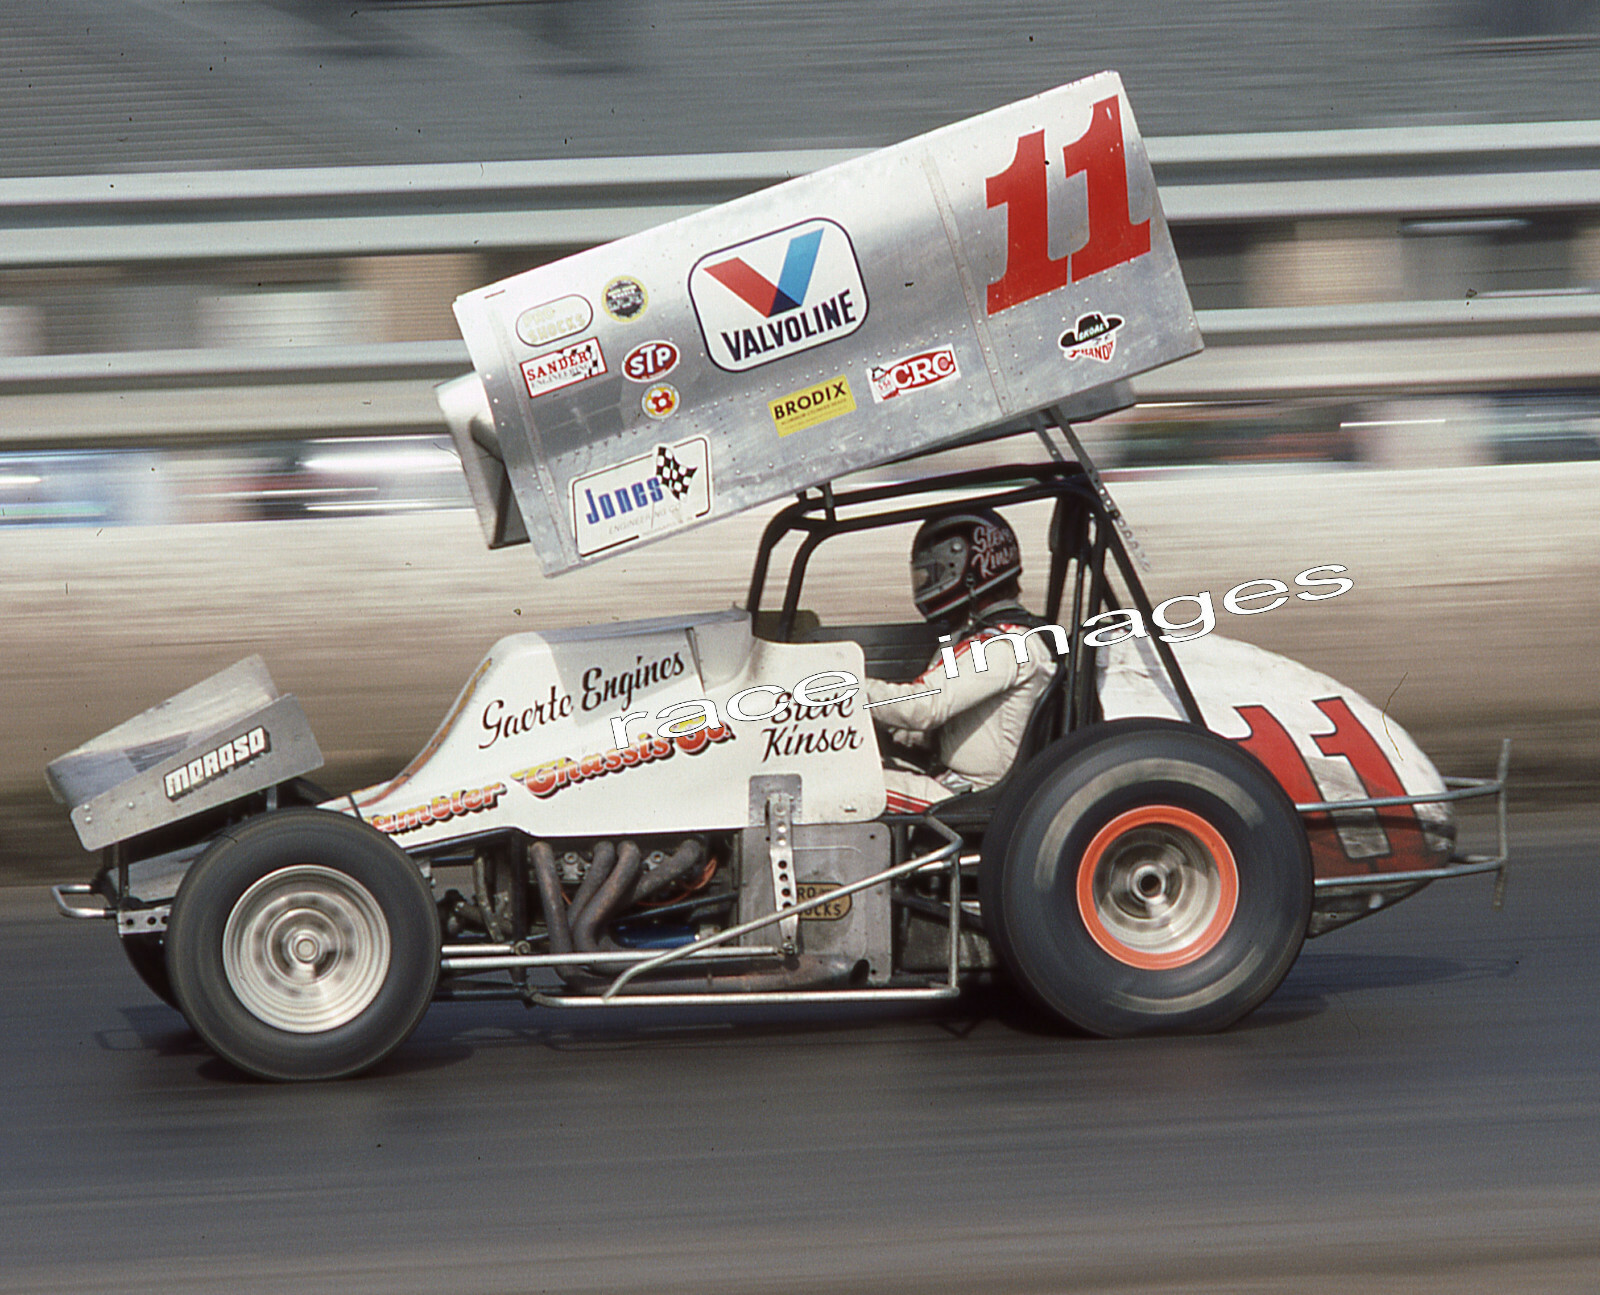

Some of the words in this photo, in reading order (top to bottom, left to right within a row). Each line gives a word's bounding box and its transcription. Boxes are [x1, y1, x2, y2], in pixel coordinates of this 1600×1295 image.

[986, 94, 1151, 316] 11
[527, 313, 586, 344] SHOCKS
[721, 288, 857, 363] VALVOLINE
[629, 343, 671, 376] STP
[890, 351, 955, 388] CRC
[774, 381, 847, 420] BRODIX
[584, 476, 664, 525] Jones
[477, 685, 574, 749] Gaerte
[580, 651, 685, 711] Engines
[761, 723, 865, 763] Kinser
[364, 782, 508, 836] ambler
